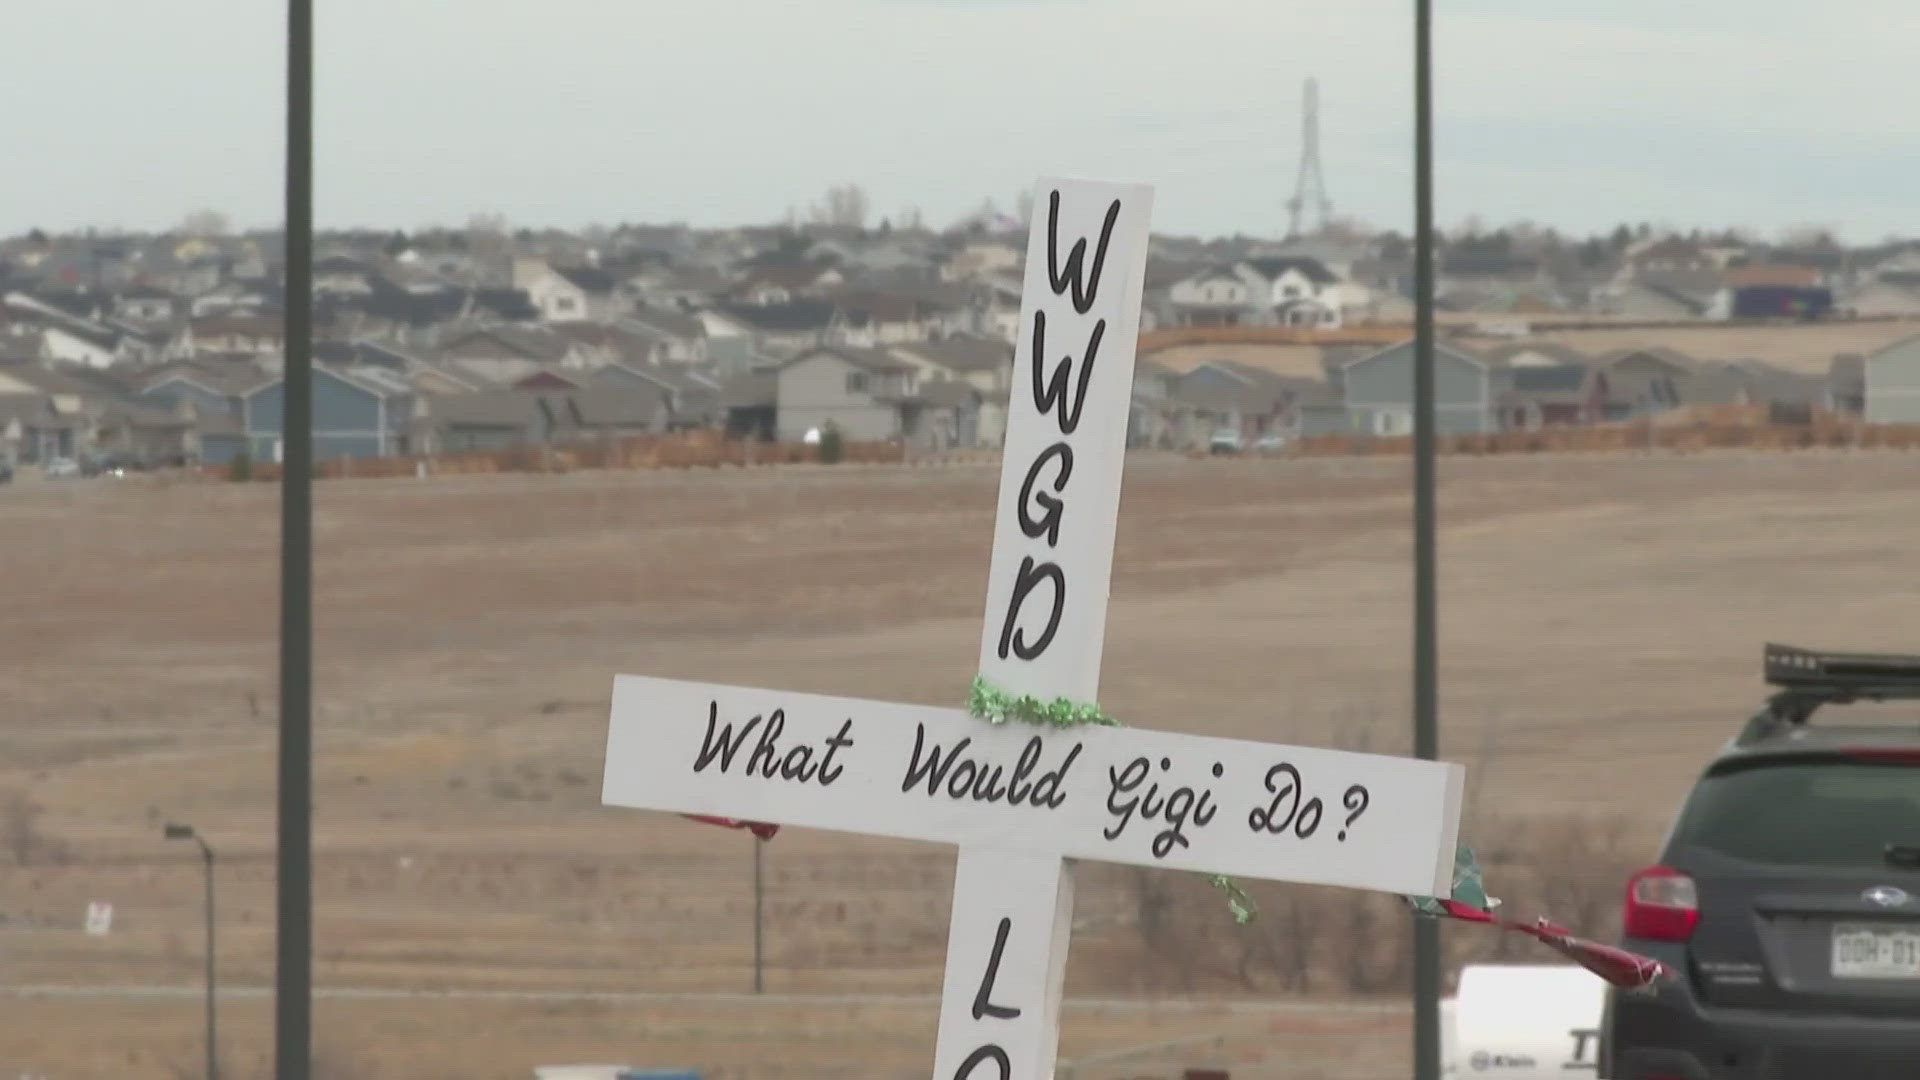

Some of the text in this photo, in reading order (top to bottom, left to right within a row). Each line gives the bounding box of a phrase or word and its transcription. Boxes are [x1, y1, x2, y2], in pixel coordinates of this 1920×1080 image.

[693, 700, 1370, 859] What Would Gigi Do?
